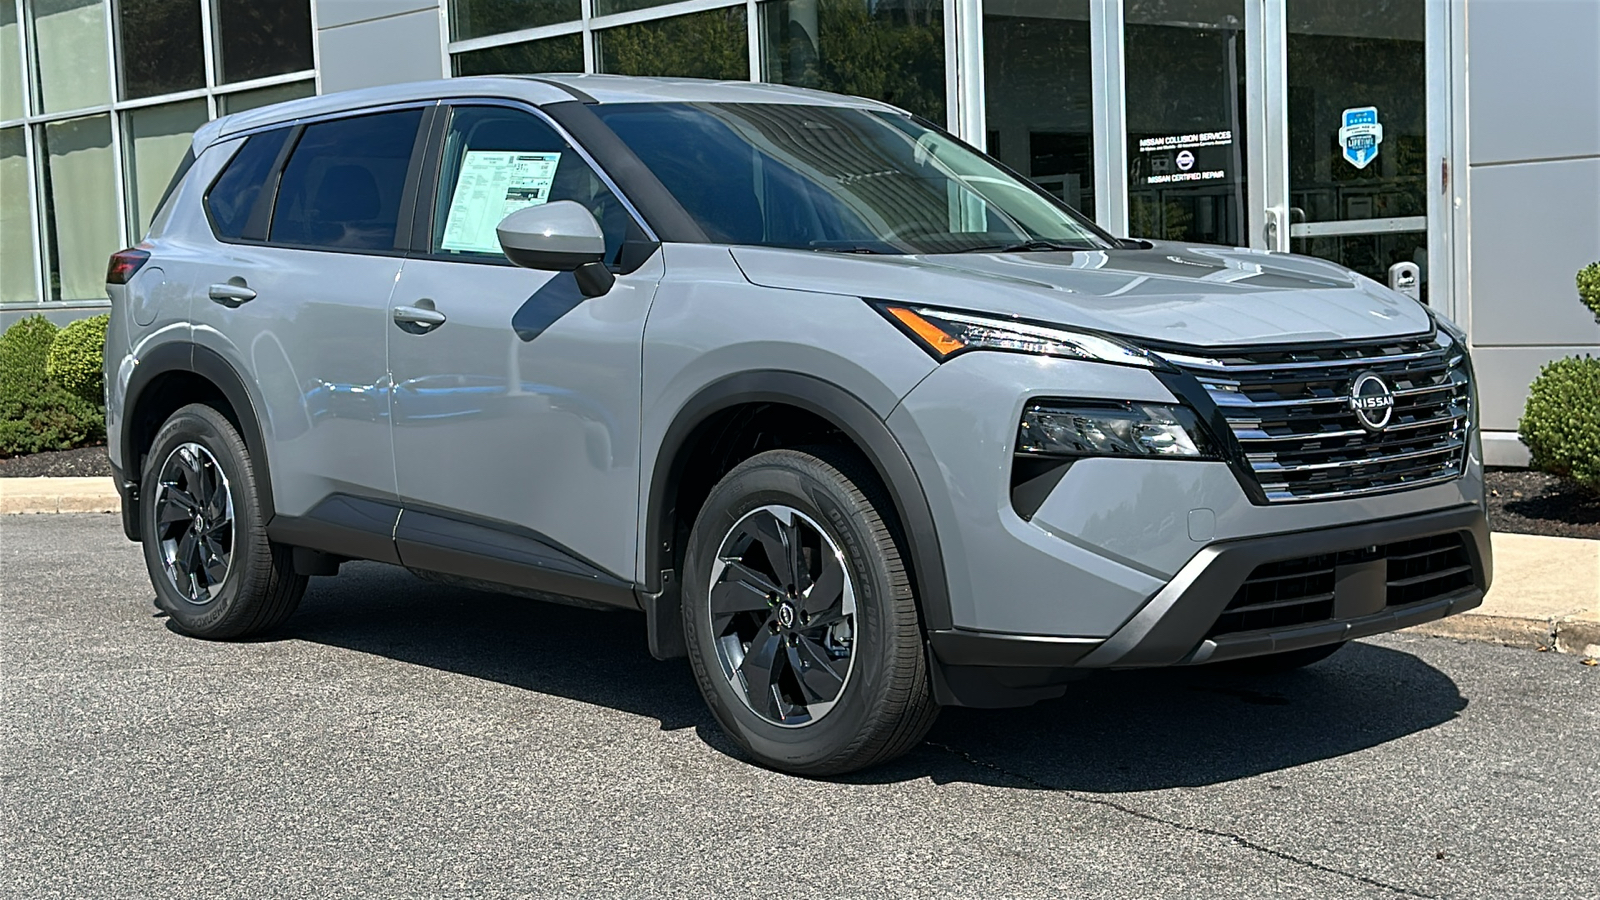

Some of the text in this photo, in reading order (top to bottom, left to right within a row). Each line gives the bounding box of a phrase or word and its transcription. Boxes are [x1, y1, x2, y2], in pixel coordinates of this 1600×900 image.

[1139, 137, 1164, 147] NISSAN
[1165, 133, 1198, 145] COLLISION
[1199, 131, 1231, 142] SERVICES
[1147, 170, 1225, 184] NISSAN CERTIFIED REPAIR
[1351, 395, 1394, 409] NISSAN
